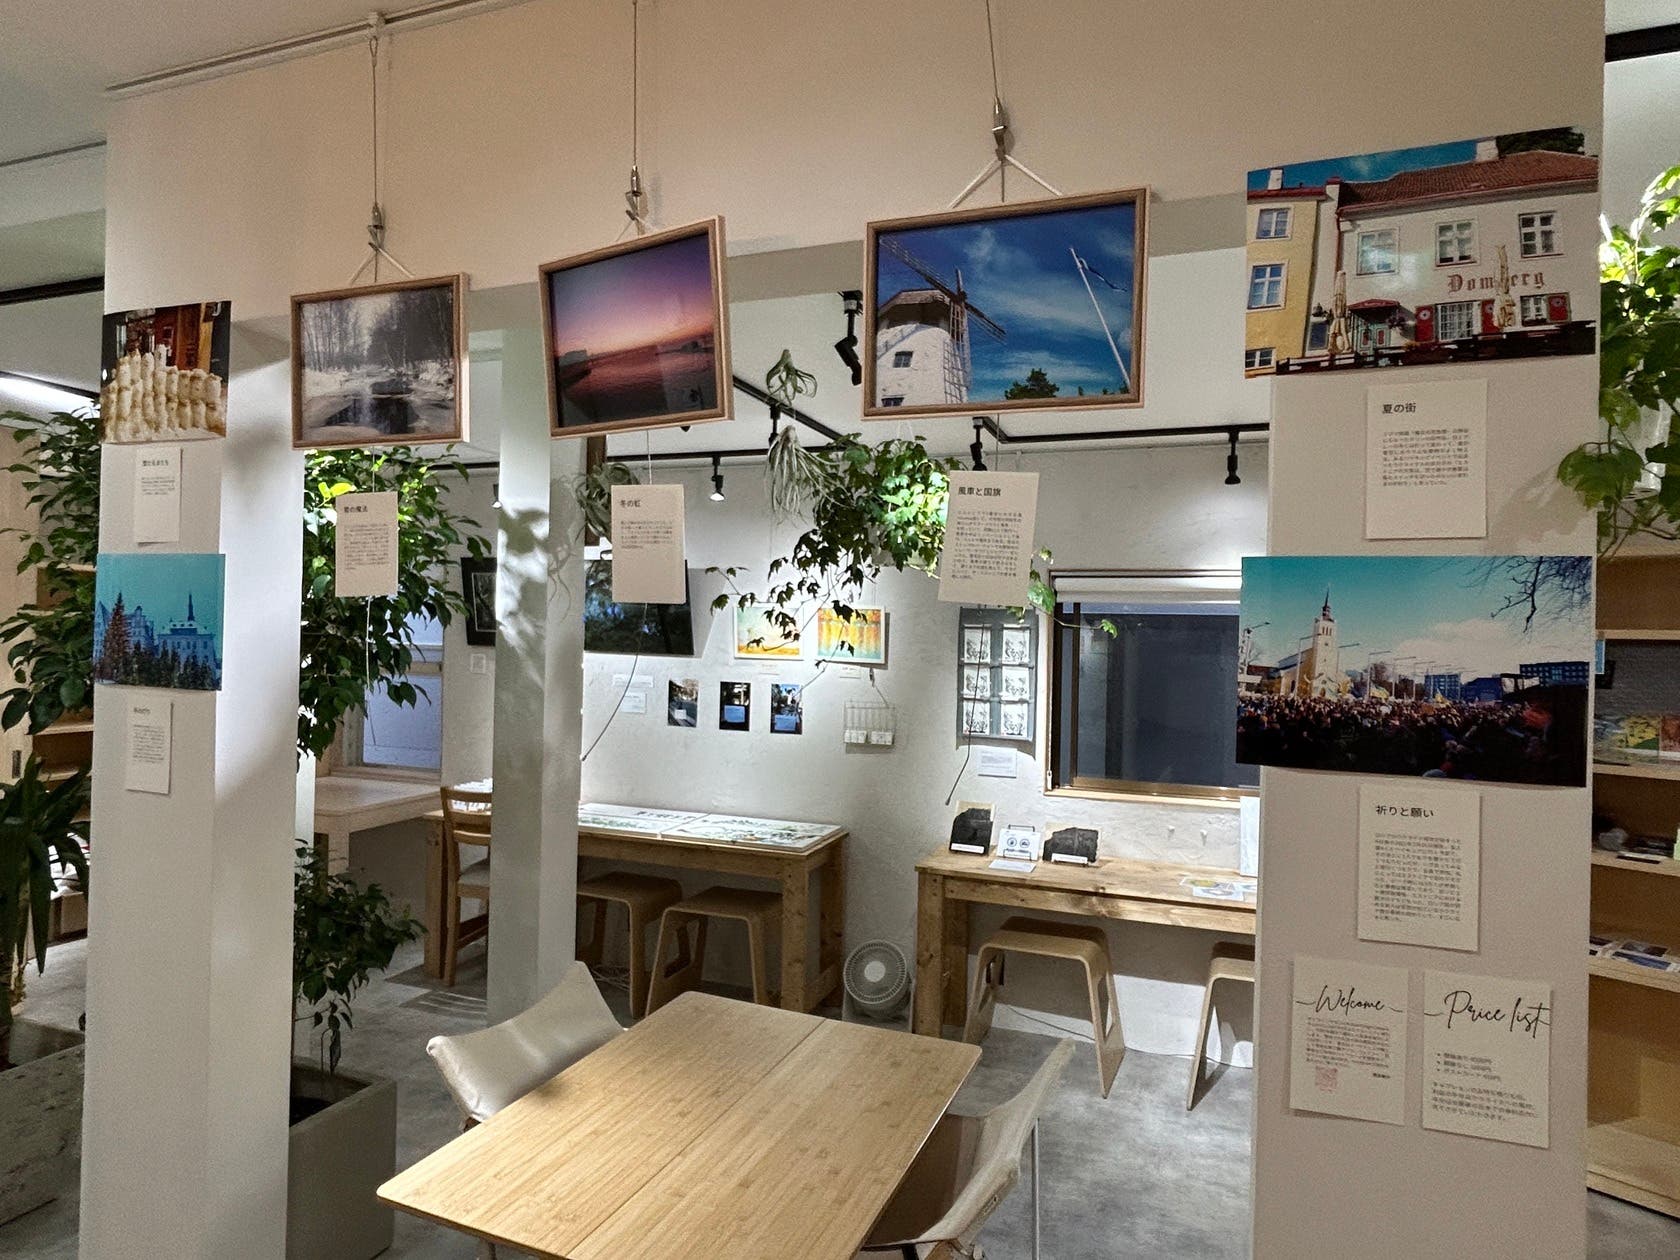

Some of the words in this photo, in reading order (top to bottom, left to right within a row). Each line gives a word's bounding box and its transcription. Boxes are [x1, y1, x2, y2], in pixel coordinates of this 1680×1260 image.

[1447, 272, 1546, 293] Domerg
[1382, 402, 1417, 414] 夏の街
[957, 486, 1002, 497] 風車と国旗
[1375, 804, 1434, 818] 祈りと願い
[1313, 984, 1387, 1016] Welcome
[1443, 989, 1506, 1029] Price
[1510, 997, 1551, 1039] list
